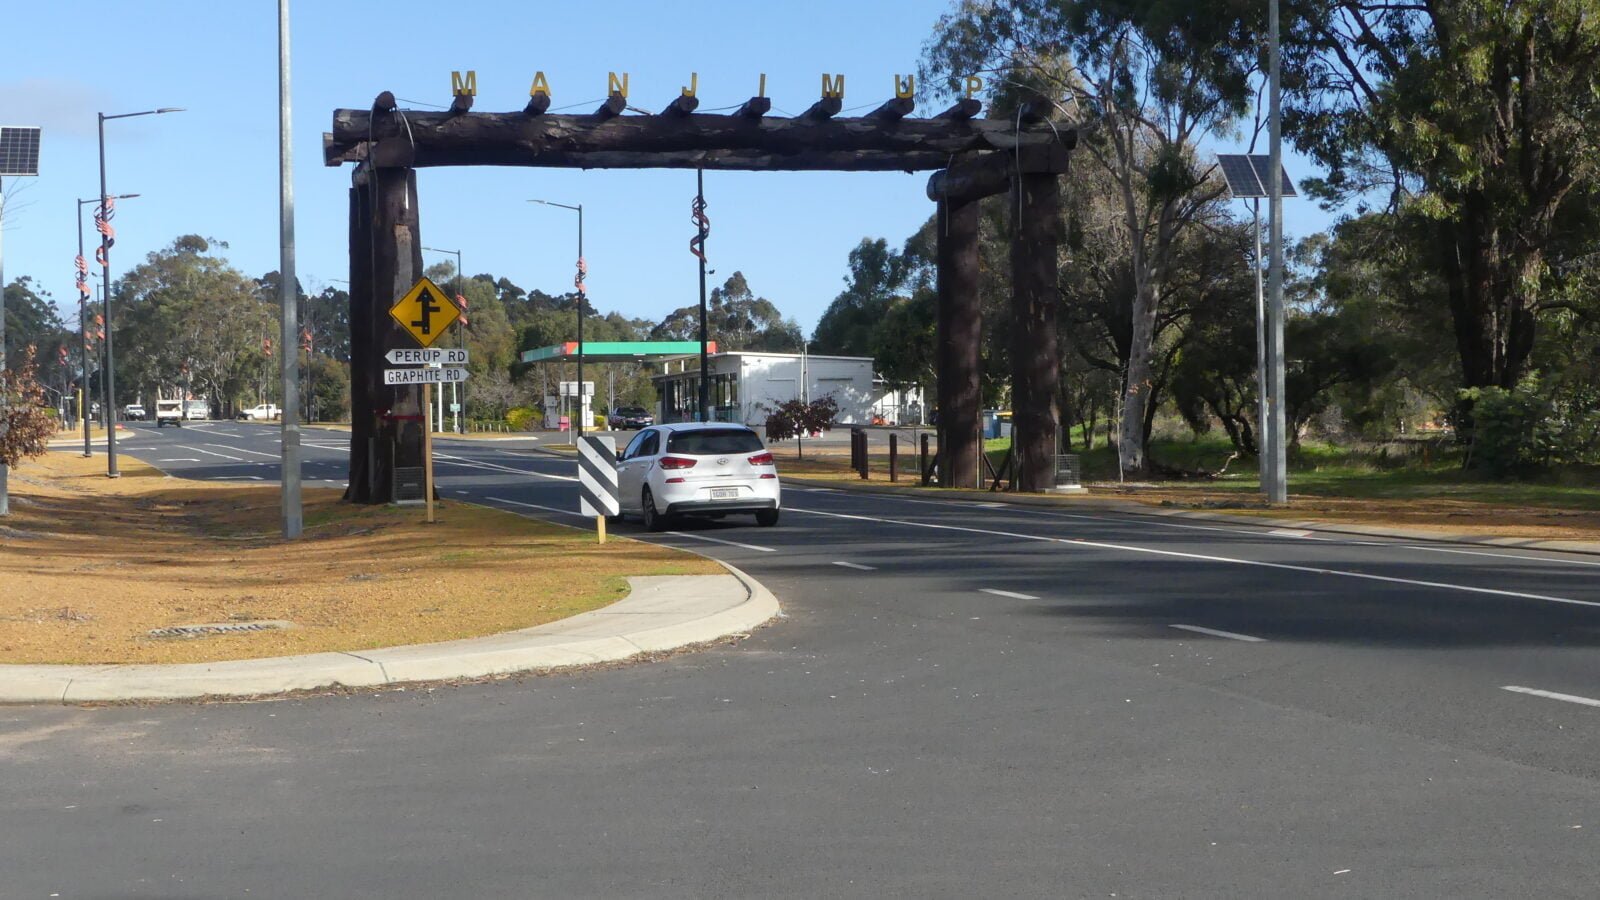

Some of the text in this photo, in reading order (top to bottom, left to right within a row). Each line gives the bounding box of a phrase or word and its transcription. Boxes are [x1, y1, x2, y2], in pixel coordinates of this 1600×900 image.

[451, 70, 983, 99] MANJIMUP
[395, 351, 466, 362] PERUP RD
[388, 369, 460, 383] GRAPHITE RD
